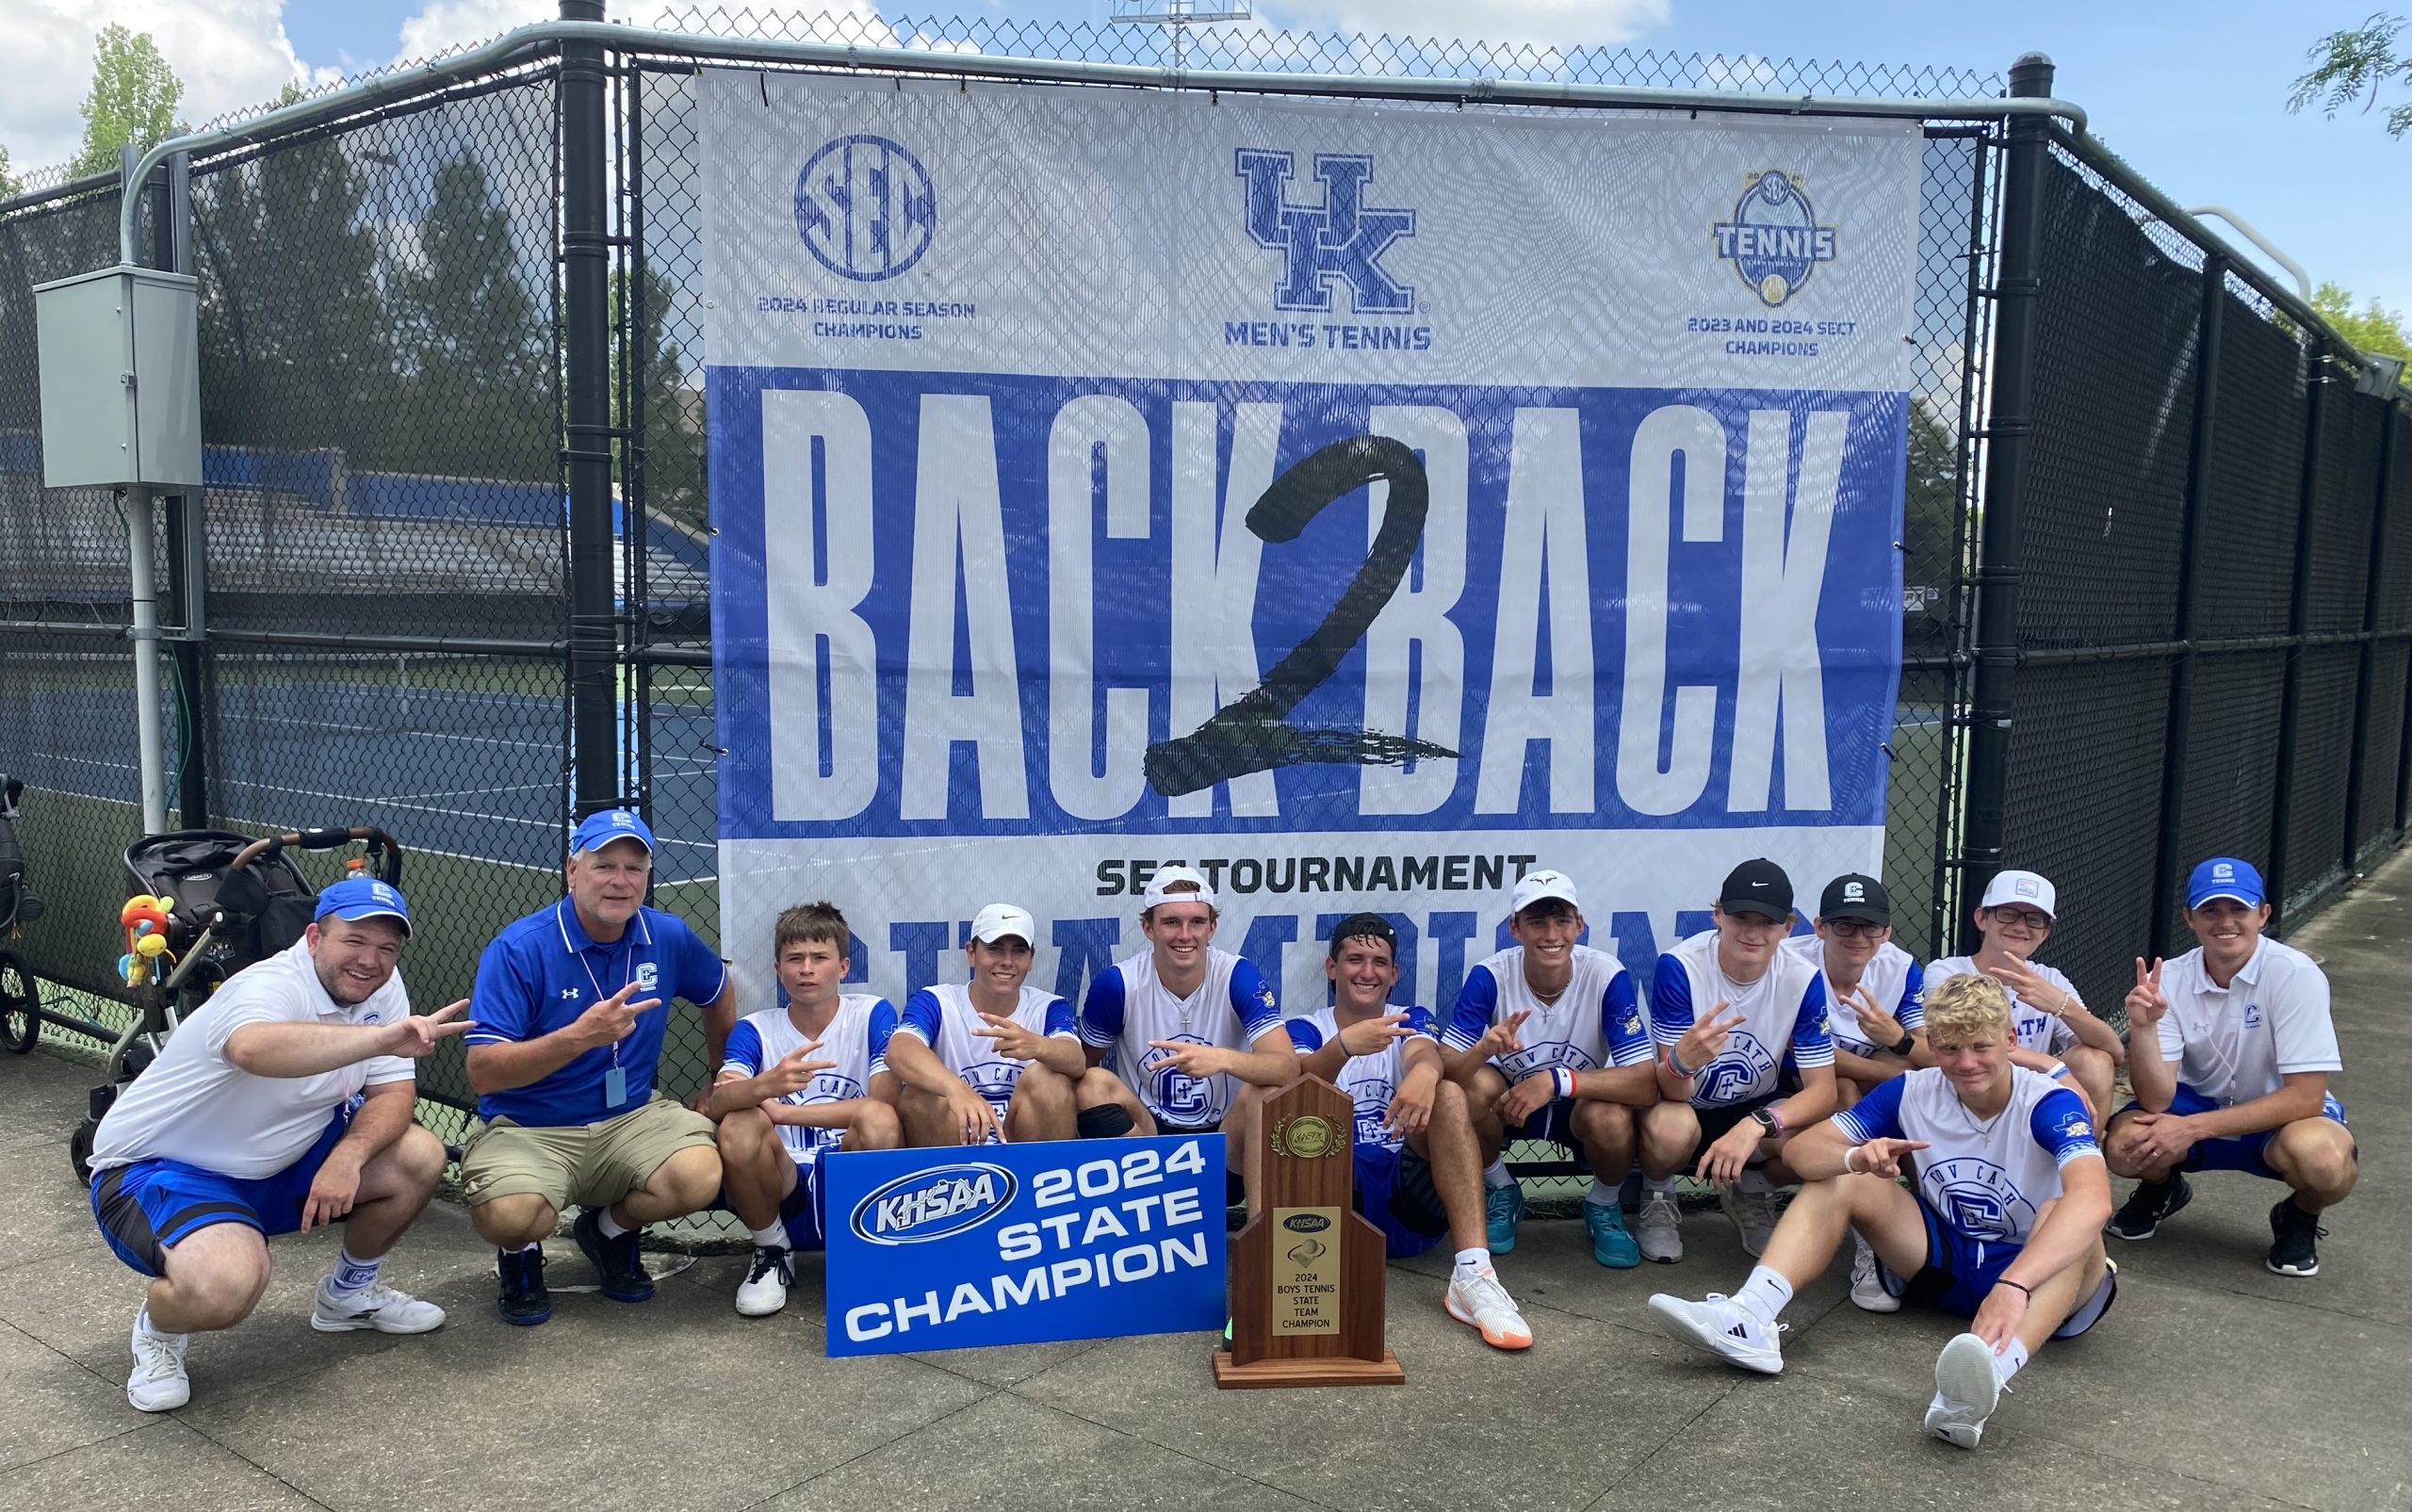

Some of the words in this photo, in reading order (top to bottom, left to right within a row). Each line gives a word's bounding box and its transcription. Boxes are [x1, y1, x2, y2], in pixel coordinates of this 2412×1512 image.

[1235, 148, 1416, 314] UK
[1717, 226, 1833, 258] TENNIS
[758, 297, 807, 314] 2024
[813, 299, 898, 317] REGULAR
[902, 301, 975, 318] SEASON
[814, 321, 922, 340] CHAMPIONS
[1225, 321, 1315, 348] MEN'S
[1322, 325, 1431, 350] TENNIS
[1687, 317, 1731, 333] 2023
[1735, 318, 1768, 333] AND
[1771, 320, 1813, 334] 2024
[1817, 321, 1856, 336] SECT
[1725, 340, 1818, 357] CHAMPIONS
[761, 388, 1283, 821] BACK
[1144, 435, 1464, 797] 2
[1359, 404, 1850, 817] BACK
[1096, 859, 1186, 896] SE
[1198, 854, 1537, 893] TOURNAMENT
[1505, 1051, 1536, 1073] COV
[1734, 1035, 1773, 1072] CATH
[1033, 1140, 1206, 1209] 2024
[1976, 1165, 2018, 1207] CAH
[875, 1172, 998, 1234] KHSAA
[997, 1188, 1203, 1261] STATE
[1289, 1218, 1325, 1229] KHSAA
[844, 1232, 1209, 1342] CHAMPION
[1278, 1285, 1301, 1294] BOYS
[1303, 1284, 1335, 1293] TENNIS
[1295, 1273, 1318, 1282] 2024
[1293, 1296, 1320, 1306] STATE
[1294, 1309, 1319, 1317] TEAM
[1282, 1319, 1330, 1328] CHAMPION
